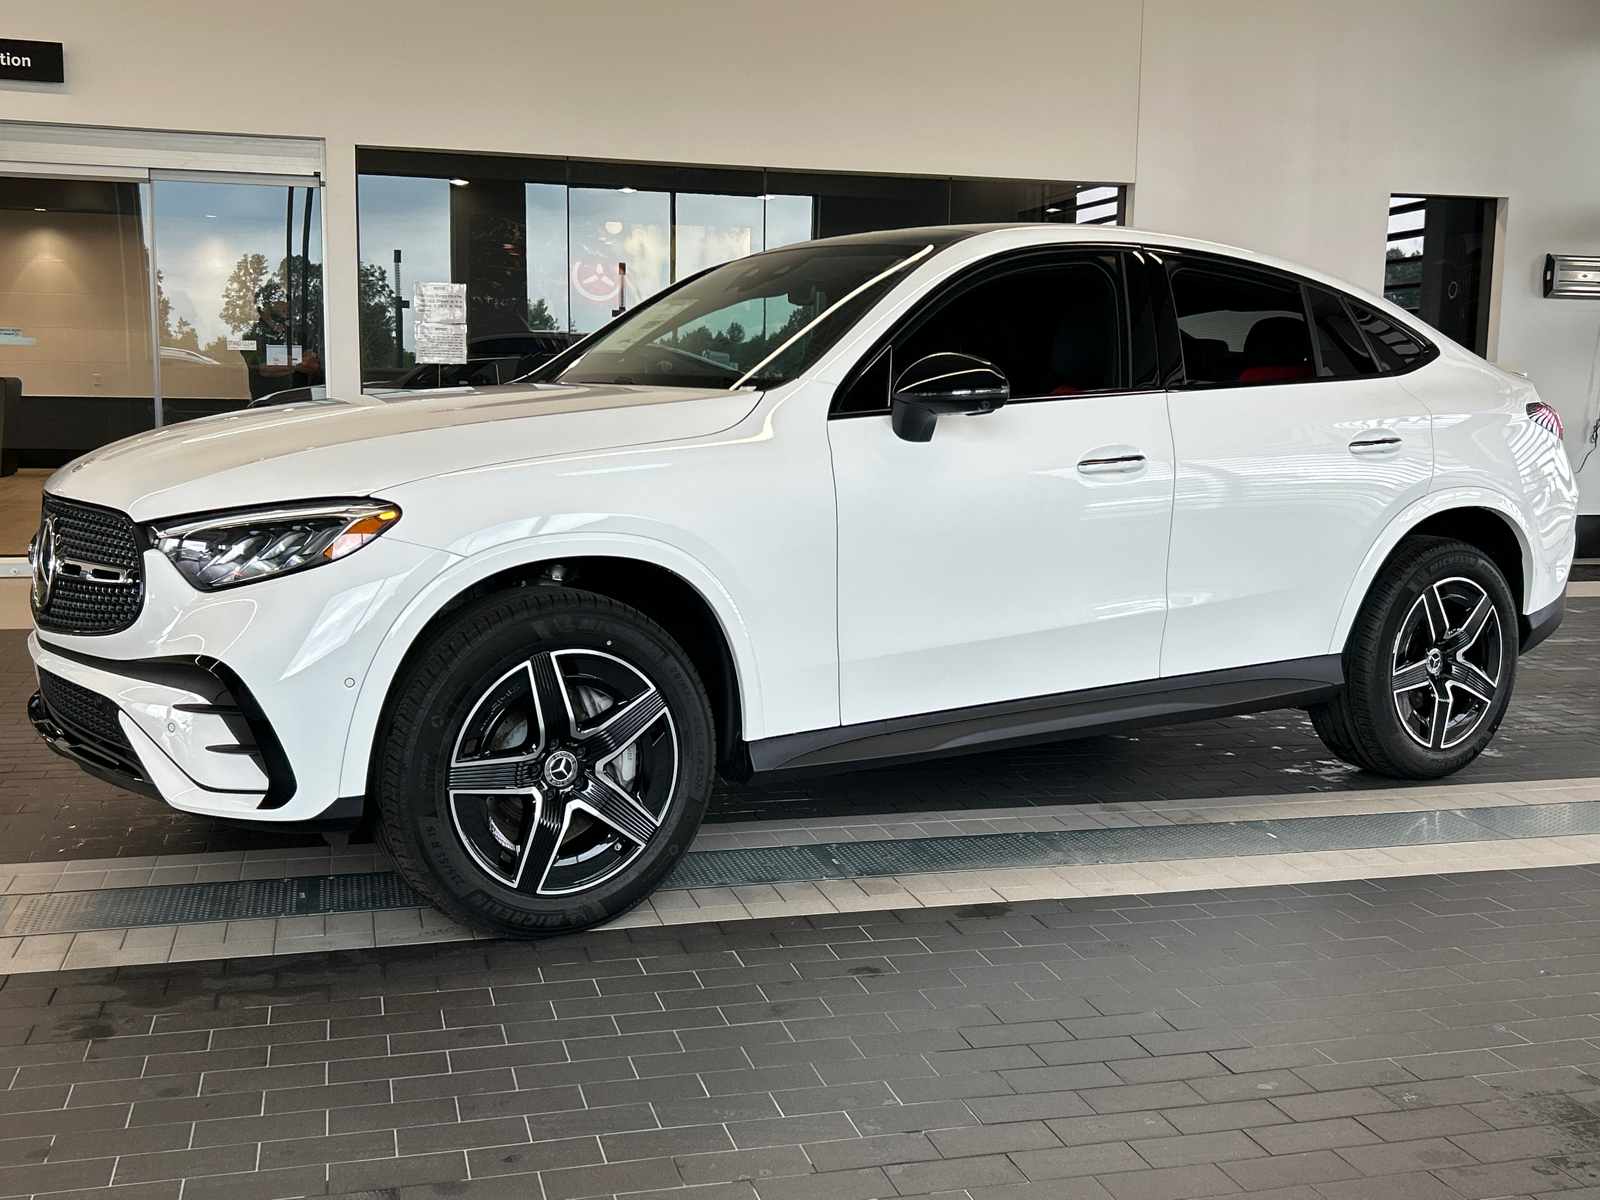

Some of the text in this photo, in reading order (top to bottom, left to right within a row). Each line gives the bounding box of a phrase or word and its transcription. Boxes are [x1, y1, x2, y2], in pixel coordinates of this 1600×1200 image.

[0, 52, 32, 67] tion
[1430, 555, 1477, 575] MICHELIN
[579, 618, 667, 661] MICHELIN
[669, 667, 706, 790] PRIMACY ALL SEASON
[419, 752, 430, 790] OUTSIDE
[426, 825, 437, 837] 19
[471, 892, 566, 926] MICHELIN
